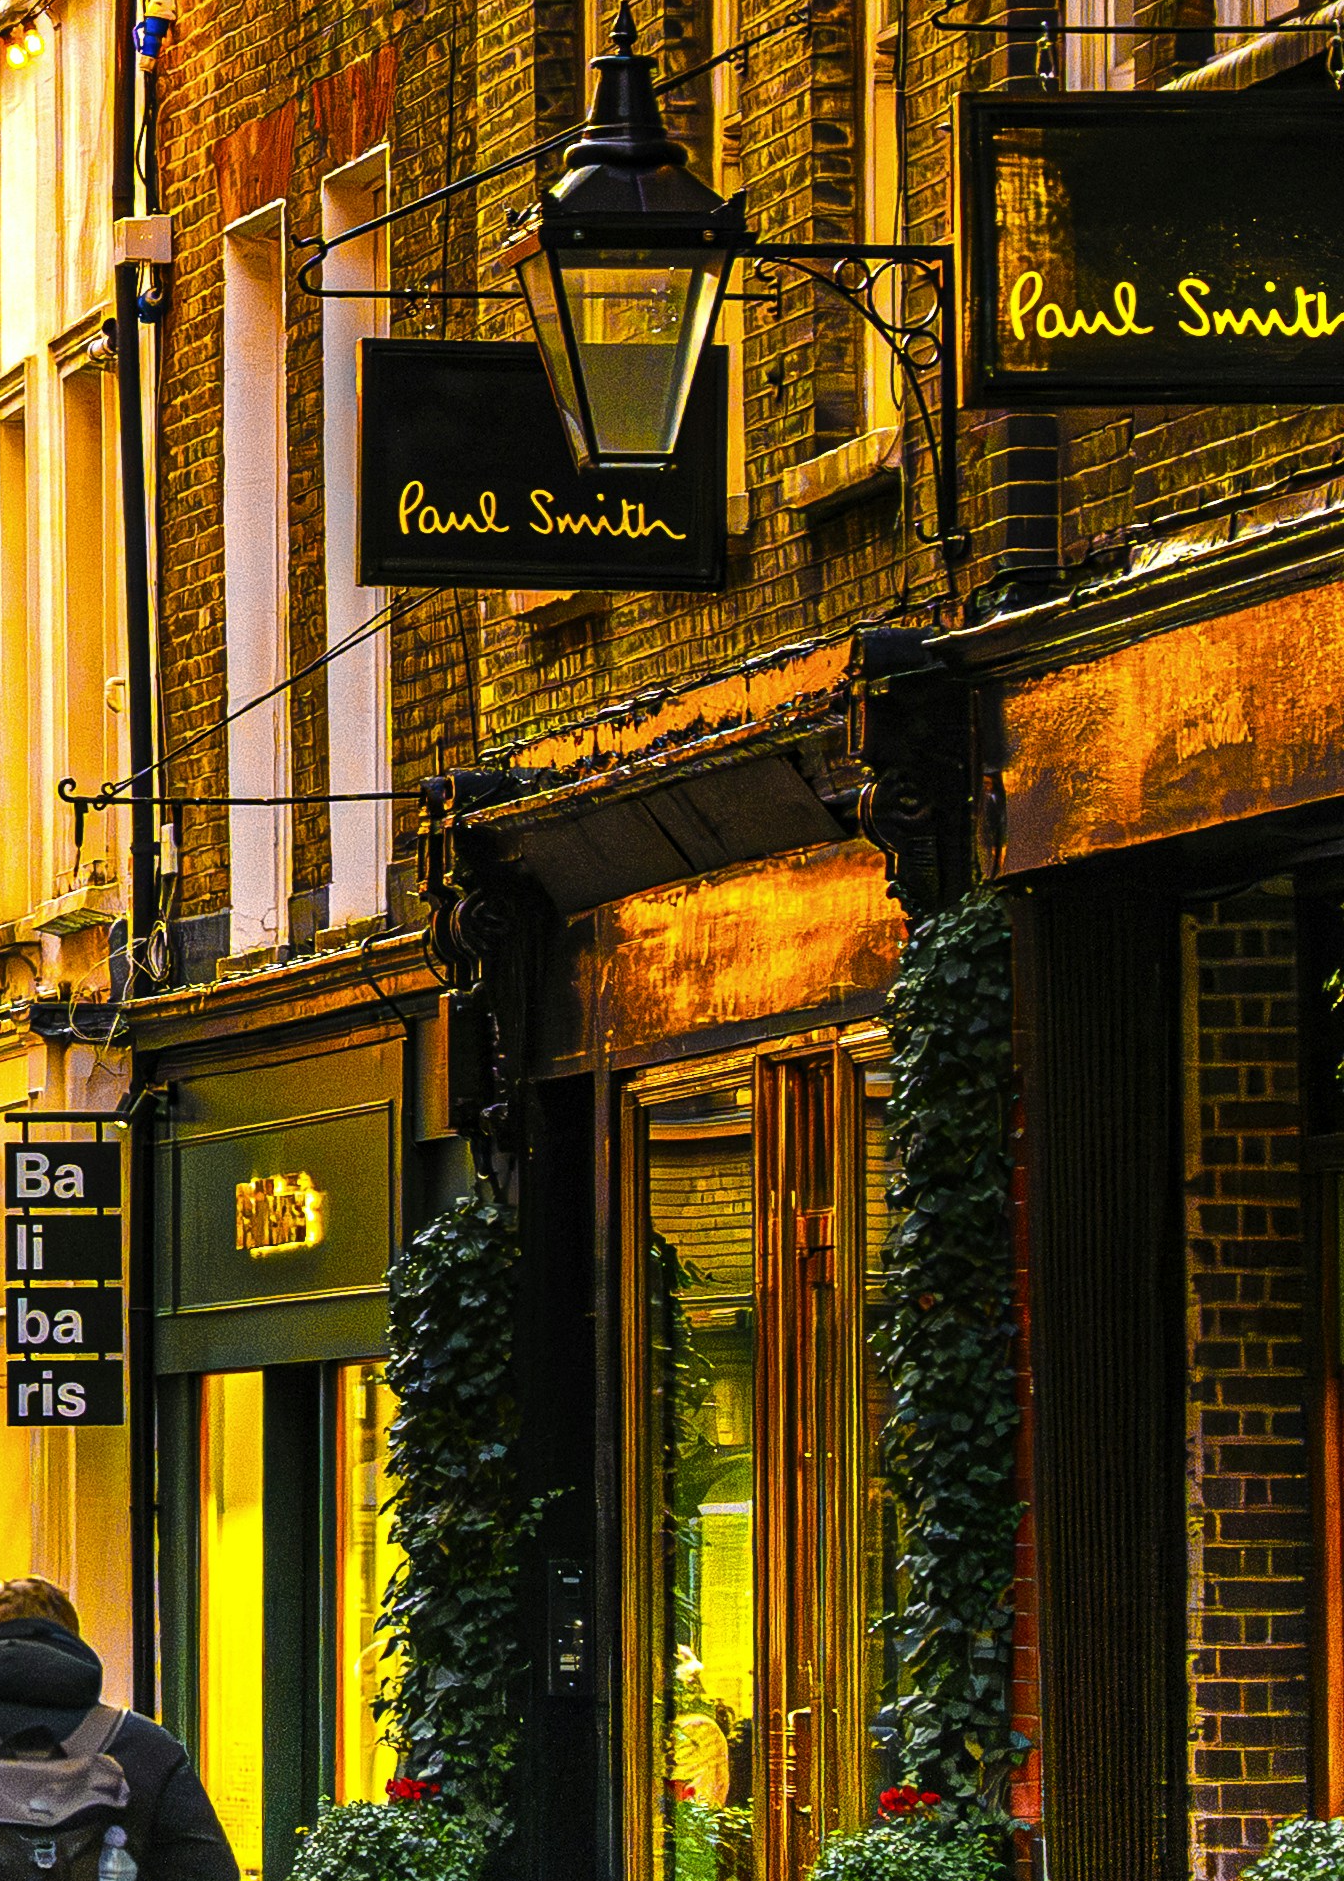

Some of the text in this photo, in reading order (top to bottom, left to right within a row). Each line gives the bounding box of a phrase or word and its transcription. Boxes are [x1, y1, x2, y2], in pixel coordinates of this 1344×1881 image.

[1010, 271, 1155, 341] Paul
[399, 480, 687, 540] Paul Smith
[15, 1152, 85, 1199] Ba
[16, 1224, 44, 1271] li
[16, 1297, 84, 1345] ba
[17, 1370, 87, 1419] ris
